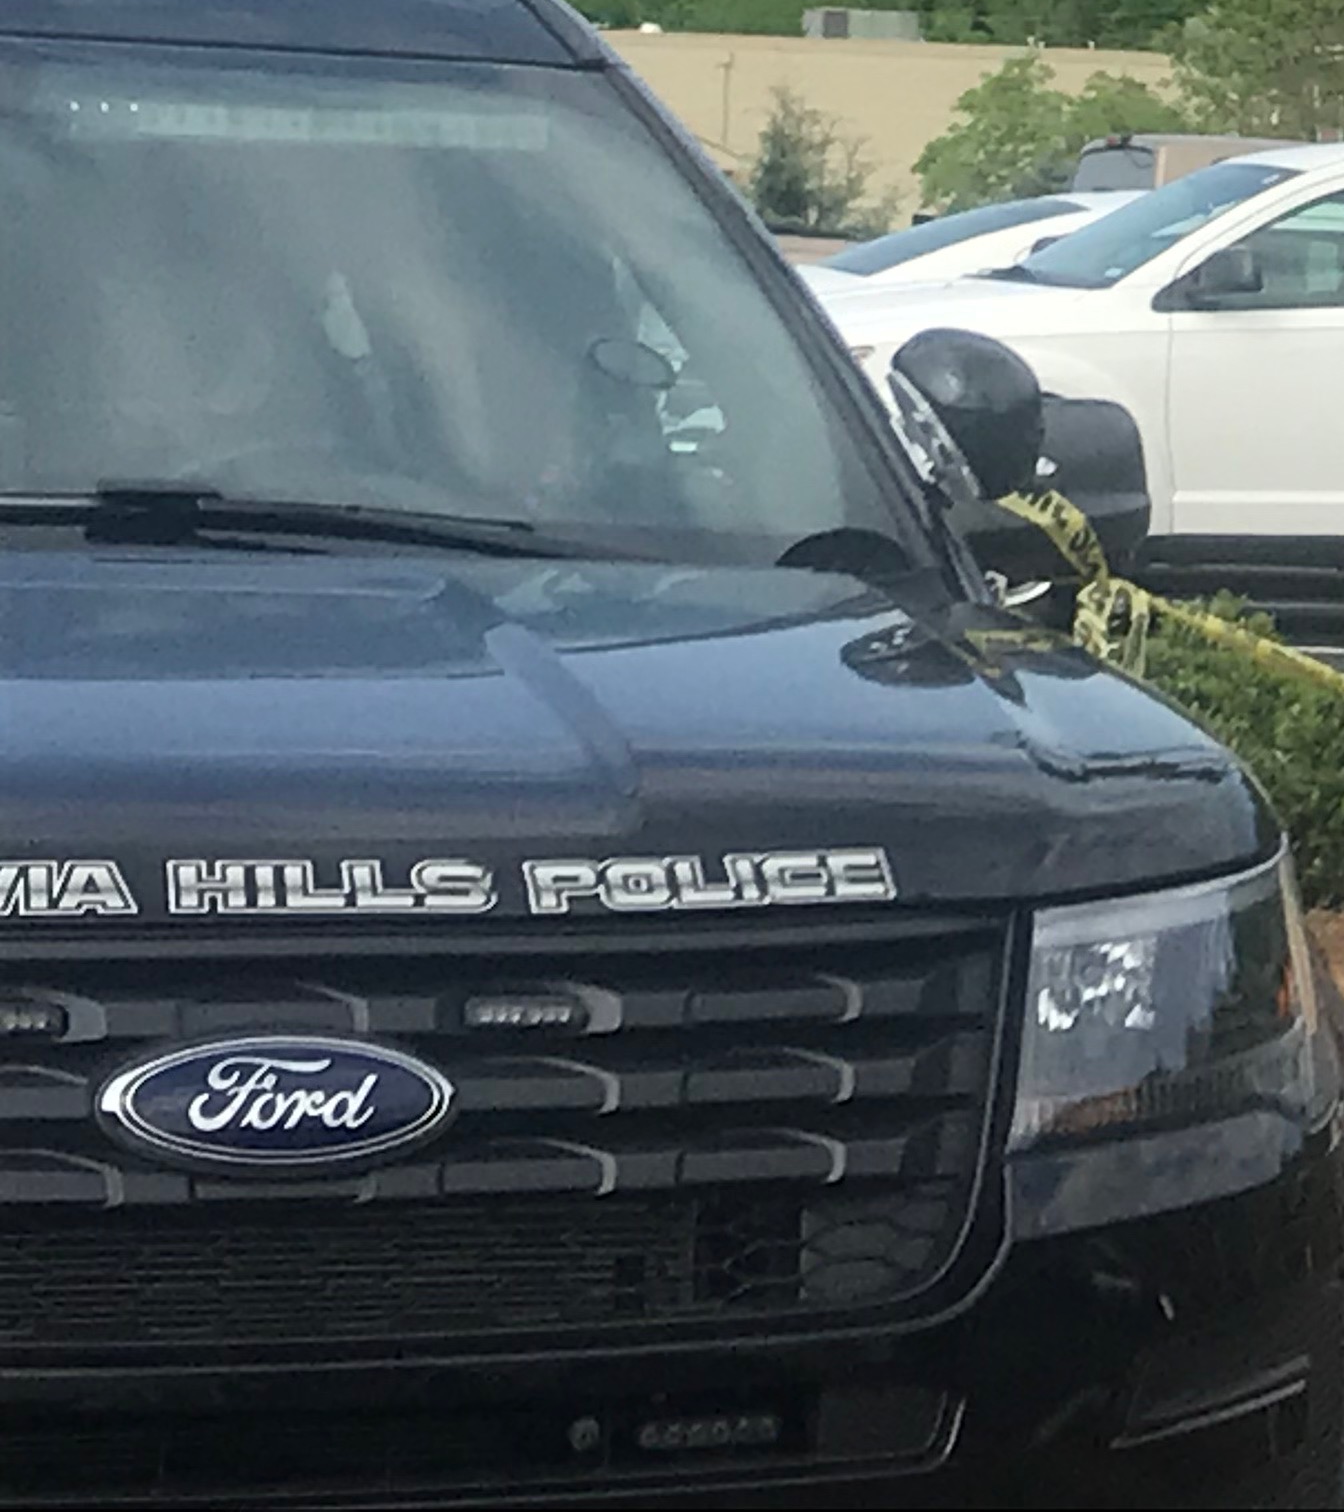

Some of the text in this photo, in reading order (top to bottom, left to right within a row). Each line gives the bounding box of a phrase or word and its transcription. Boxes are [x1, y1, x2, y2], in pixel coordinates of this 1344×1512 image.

[166, 859, 498, 915] HILLS
[521, 847, 898, 914] POLICE
[188, 1055, 379, 1132] Ford
